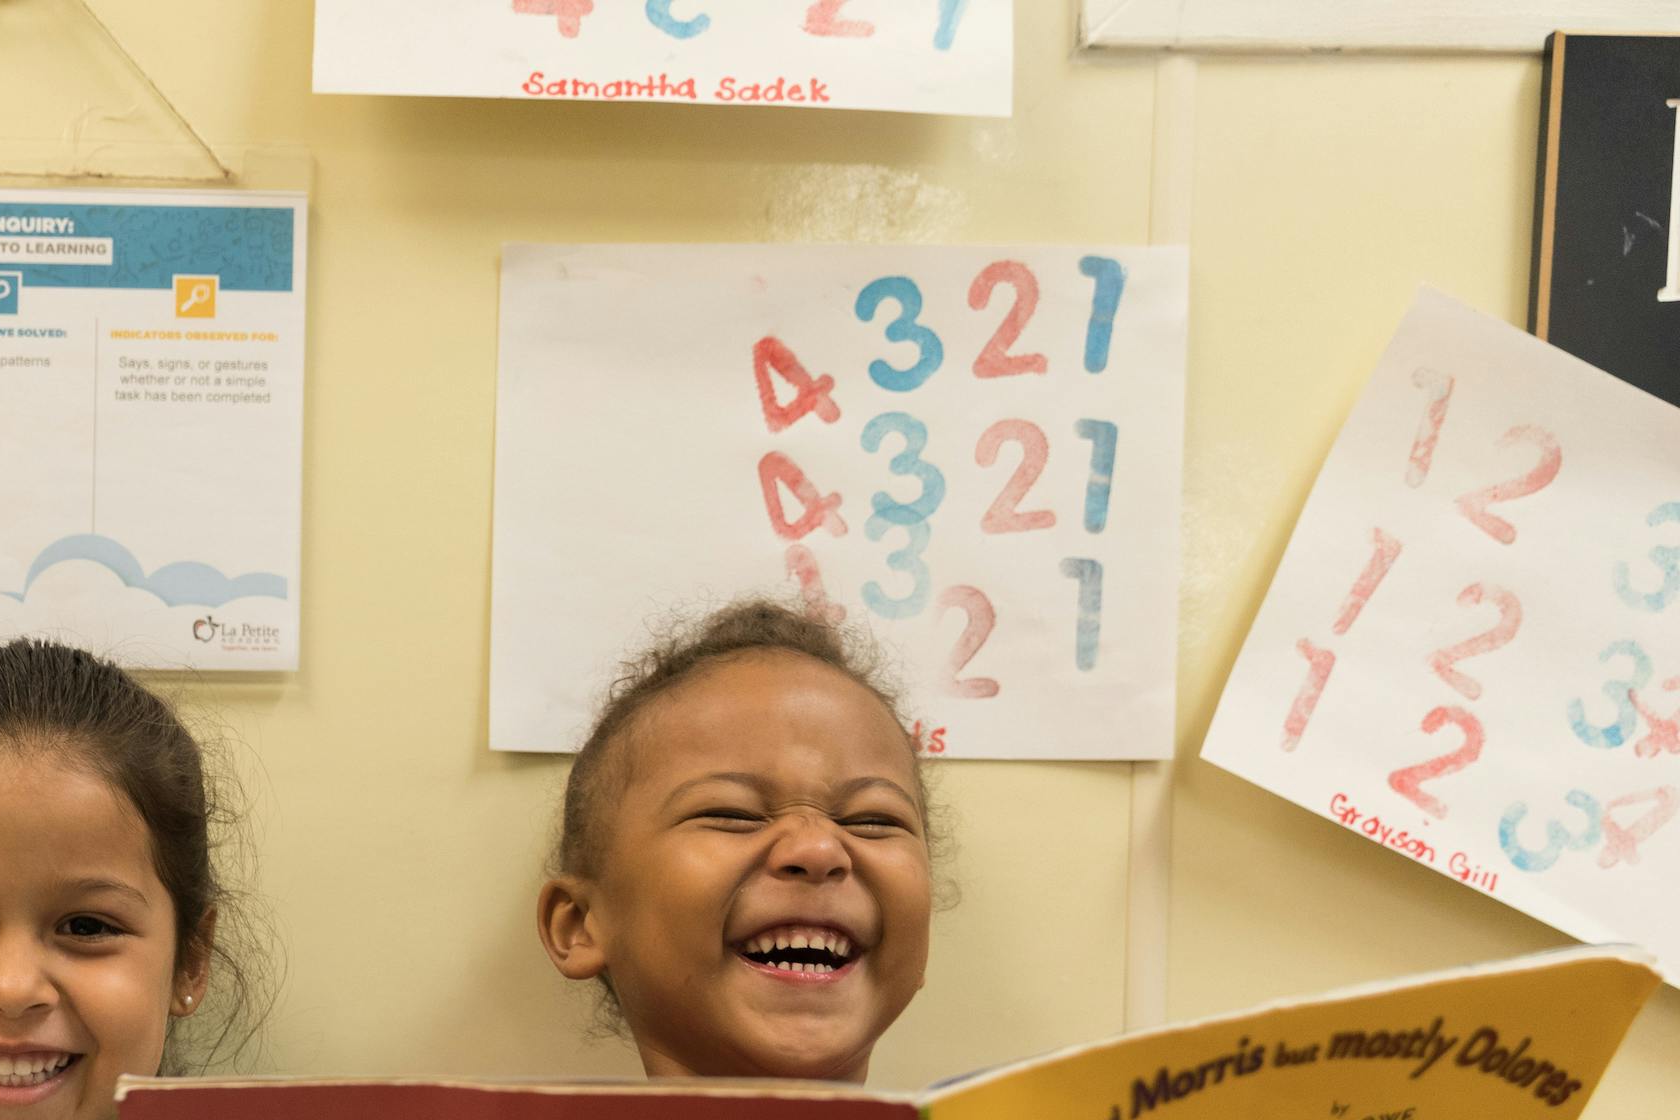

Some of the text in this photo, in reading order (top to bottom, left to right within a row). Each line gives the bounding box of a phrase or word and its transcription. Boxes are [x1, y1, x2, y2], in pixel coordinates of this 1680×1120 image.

[521, 71, 830, 101] Samantha Sadek
[0, 241, 21, 254] TO
[25, 242, 108, 256] LEARNING
[17, 327, 67, 338] SOLVED:
[110, 329, 182, 341] INDICATORS
[185, 331, 248, 342] OBSERVED
[752, 255, 1127, 434] 4 3 2 1
[0, 355, 50, 368] patterns
[119, 356, 268, 372] Says, signs, or gestures
[120, 373, 170, 386] whether
[174, 376, 187, 386] or
[190, 375, 210, 386] not
[225, 374, 266, 388] simple
[115, 389, 270, 404] task has been completed
[757, 411, 1118, 540] 4 3 2 1
[1406, 367, 1680, 612] 1 2 3
[860, 508, 1103, 698] 3 2 1
[221, 622, 279, 637] La Petite
[1333, 526, 1653, 749] 1 2 3
[1281, 638, 1680, 872] 1 2 3 4
[1330, 793, 1498, 892] Grayson Gill
[1130, 1037, 1265, 1120] Morris
[1273, 1042, 1319, 1068] but
[1326, 1015, 1458, 1080] mostly
[1455, 1025, 1582, 1107] Dolores
[1330, 1101, 1350, 1117] by
